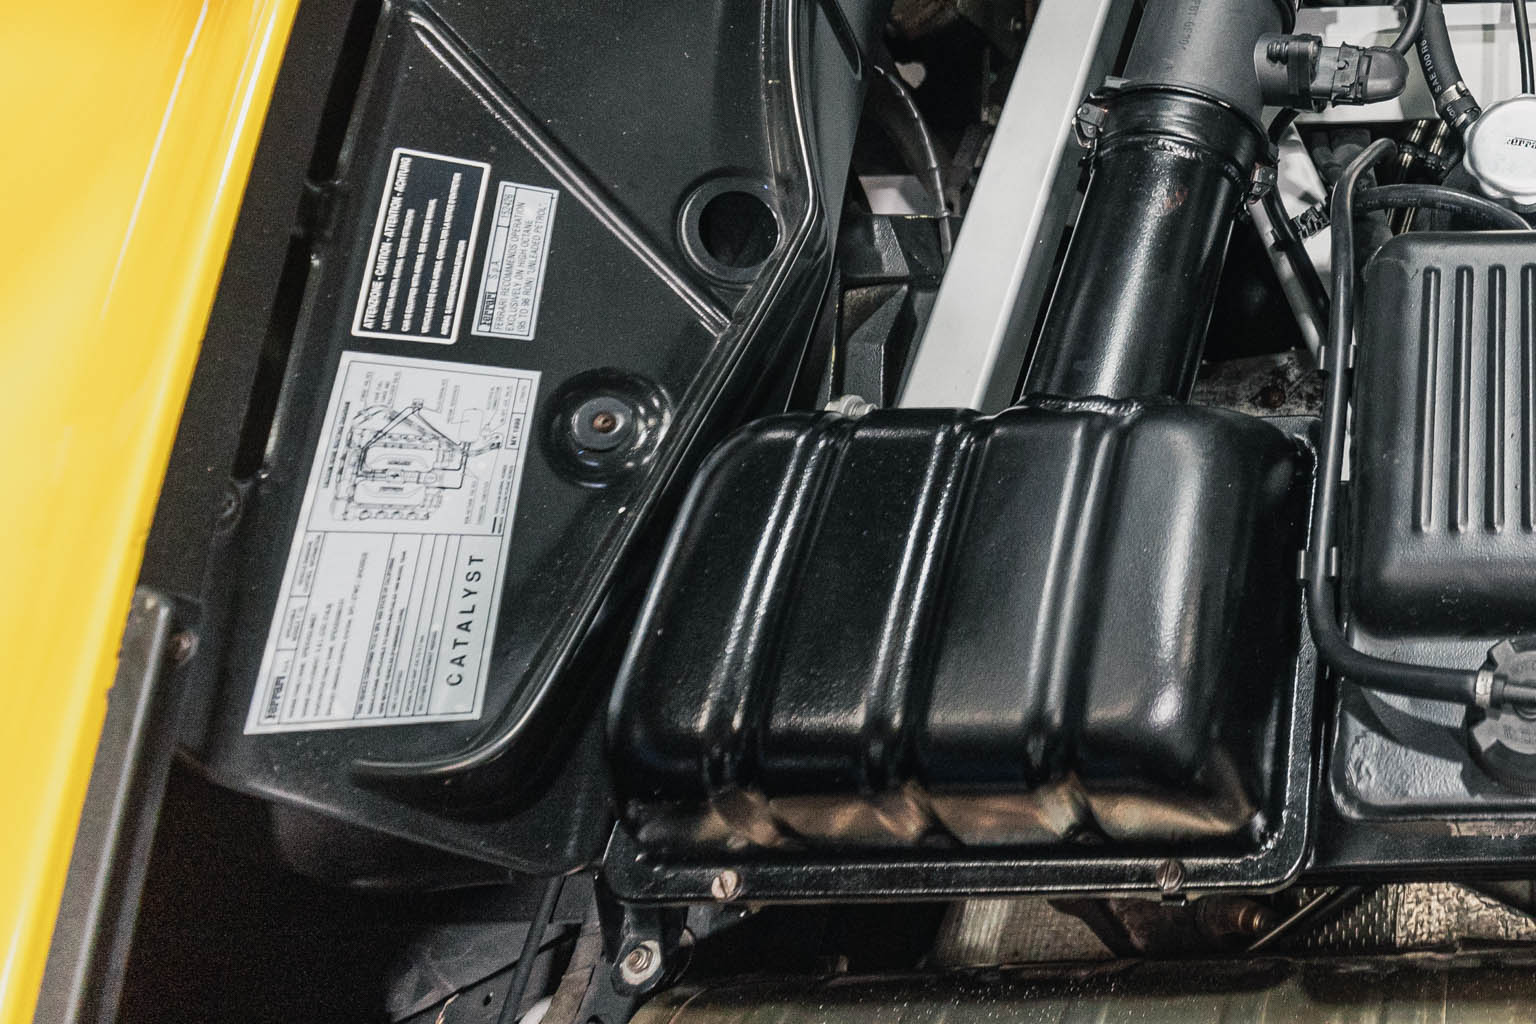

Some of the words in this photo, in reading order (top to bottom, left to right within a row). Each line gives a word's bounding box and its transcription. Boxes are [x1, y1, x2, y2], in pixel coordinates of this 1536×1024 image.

[1423, 53, 1434, 72] 100
[1428, 71, 1442, 93] SAE
[363, 281, 384, 328] ATTENZIONE
[375, 242, 392, 276] CAUTION
[384, 197, 402, 237] ATTENTION
[394, 158, 412, 192] ACHTUNG
[521, 221, 533, 247] OCTANE
[494, 298, 506, 329] FERRARI
[500, 244, 517, 296] RECOMMENDS
[511, 202, 525, 242] OPERATION
[518, 249, 527, 267] HIGH
[515, 270, 524, 280] ON
[479, 292, 497, 327] Ferrari
[505, 283, 521, 331] EXCLUSIVELY
[519, 309, 528, 317] TO
[447, 556, 483, 686] CATALYST
